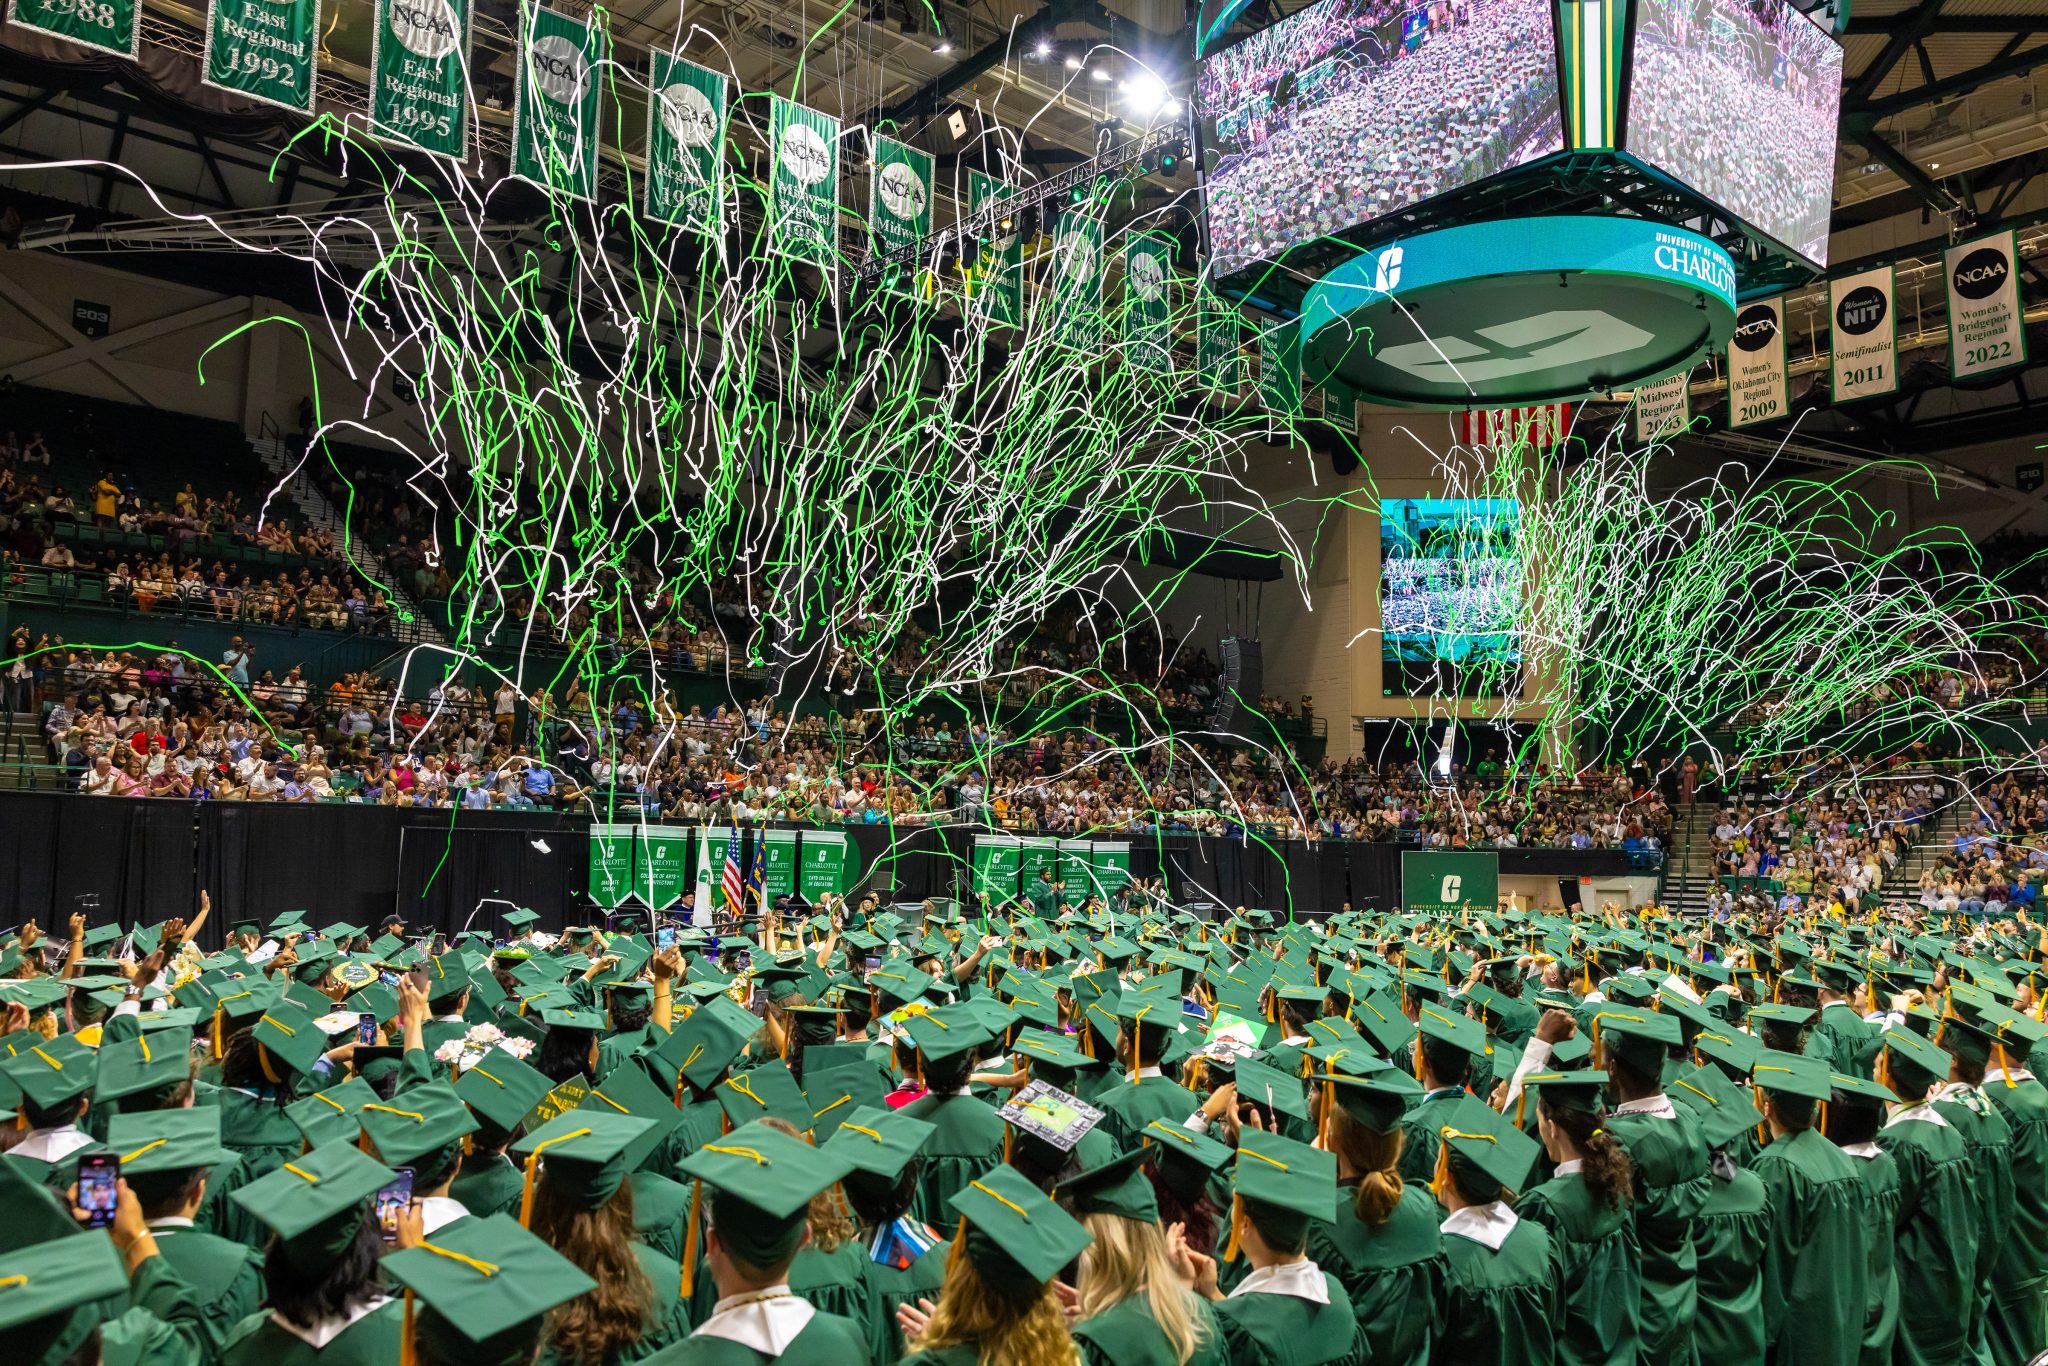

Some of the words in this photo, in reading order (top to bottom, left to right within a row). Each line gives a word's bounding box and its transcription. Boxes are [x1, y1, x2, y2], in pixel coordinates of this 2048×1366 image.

[242, 1, 286, 30] East
[393, 4, 455, 39] NCAA
[222, 16, 304, 57] Regional
[227, 48, 295, 87] 1992
[404, 58, 442, 84] East
[385, 74, 460, 109] Regional
[389, 103, 451, 136] 1995
[882, 177, 923, 203] NCAA
[1656, 232, 1702, 252] UNIVERSITY
[1956, 262, 2006, 287] NCAA
[1844, 295, 1879, 309] Women's
[1961, 302, 2007, 320] Women's
[76, 307, 109, 323] 203
[1844, 304, 1880, 327] NIT
[1958, 312, 2012, 333] Bridgeport
[1735, 318, 1775, 338] NCAA
[1964, 324, 2008, 343] Regional
[1835, 341, 1892, 361] Semifinalist
[1965, 341, 2012, 366] 2022
[1742, 361, 1771, 376] Women's
[1844, 364, 1884, 386] 2011
[1732, 376, 1766, 391] Oklahoma
[1767, 371, 1781, 383] City
[1640, 388, 1682, 405] Midwest
[1743, 387, 1772, 402] Regional
[1640, 399, 1684, 418] Regional
[1739, 399, 1777, 422] 2009
